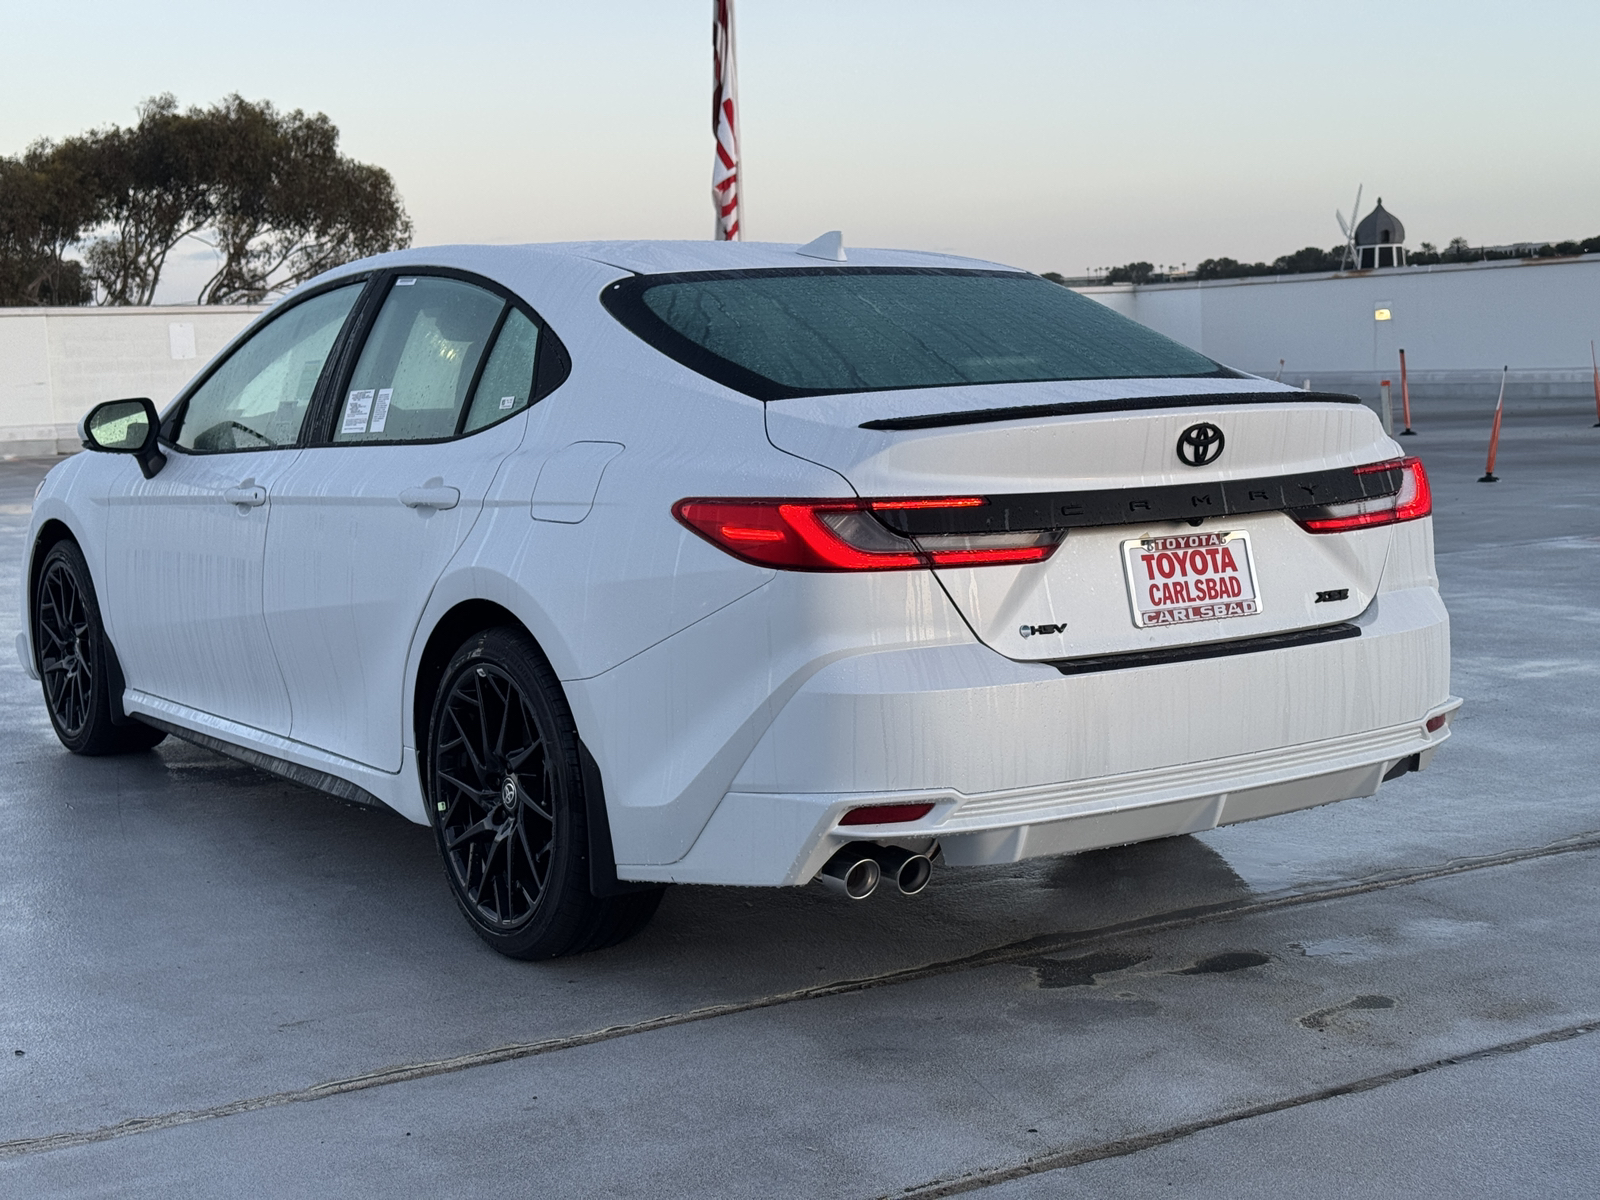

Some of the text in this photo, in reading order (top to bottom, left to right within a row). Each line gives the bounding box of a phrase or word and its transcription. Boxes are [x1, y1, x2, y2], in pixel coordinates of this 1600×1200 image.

[1061, 483, 1318, 516] CAMRY
[1156, 534, 1219, 550] TOYOTA
[1141, 547, 1239, 580] TOYOTA
[1149, 576, 1242, 606] CARLSBAD
[1314, 588, 1349, 604] XSE
[1143, 601, 1257, 624] CARLSBAD
[1030, 623, 1068, 636] HEV
